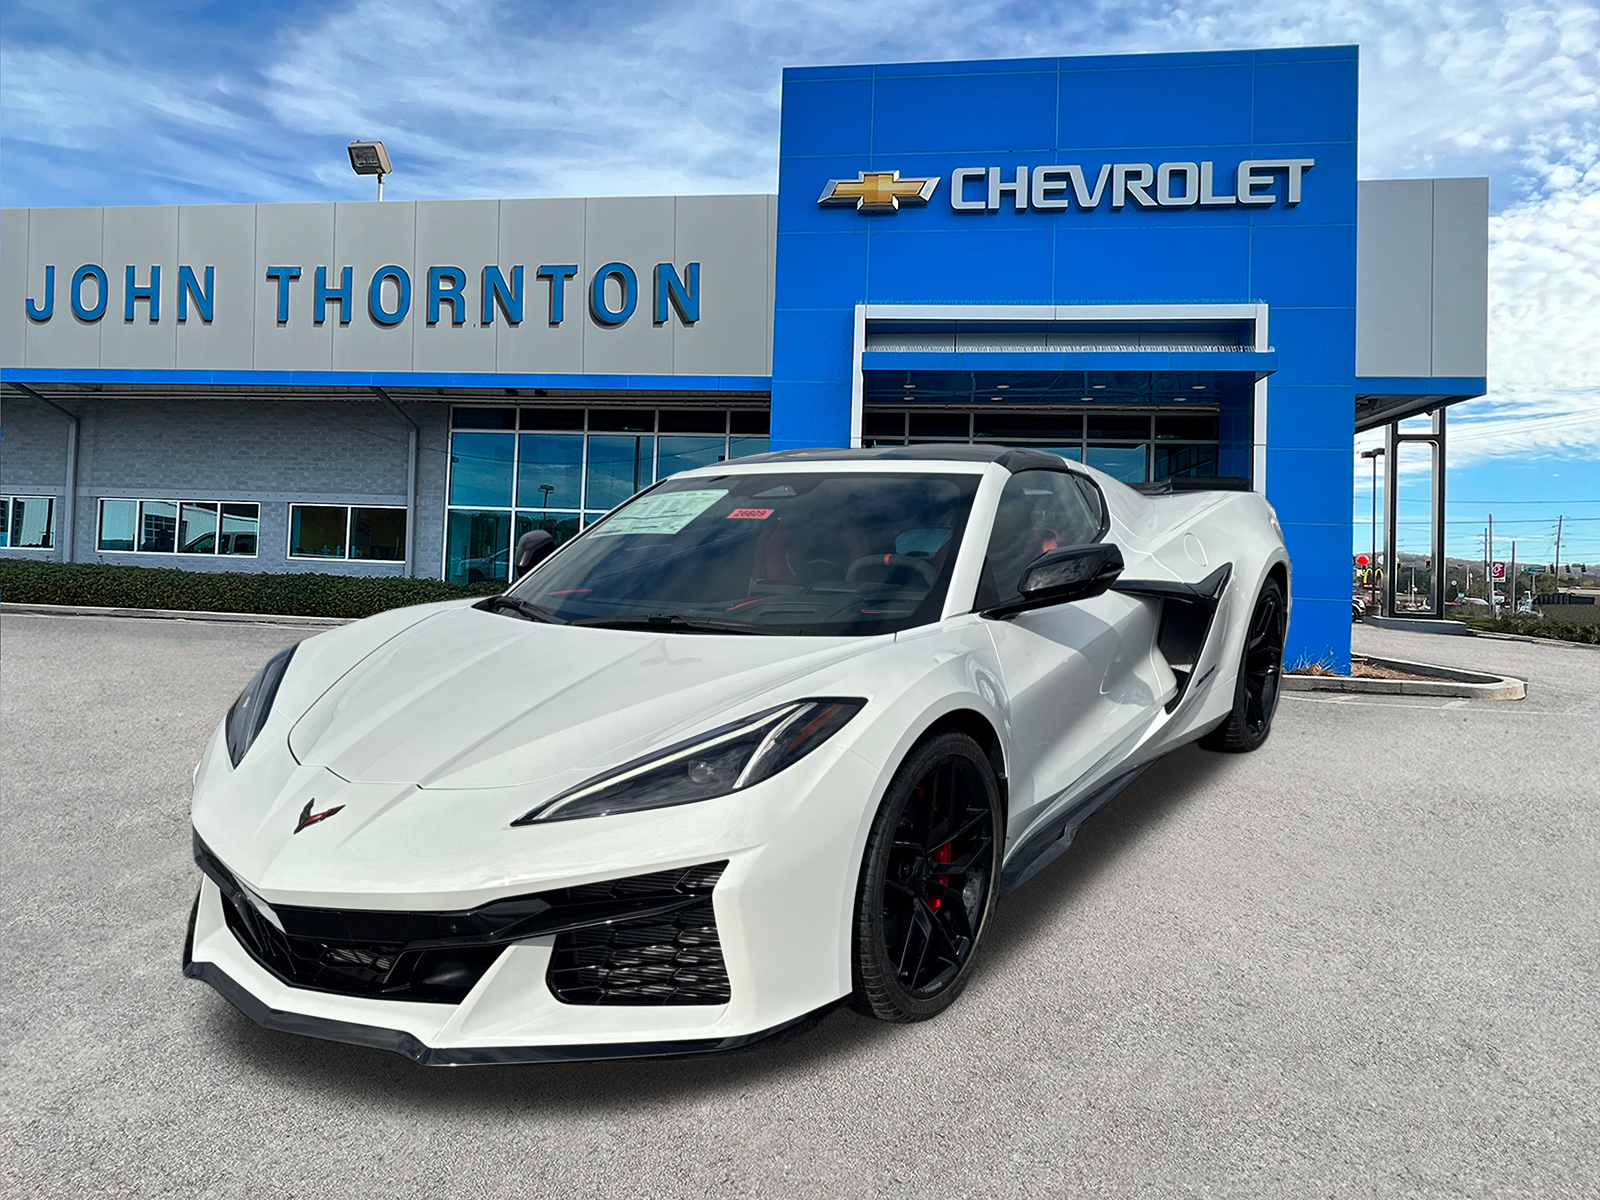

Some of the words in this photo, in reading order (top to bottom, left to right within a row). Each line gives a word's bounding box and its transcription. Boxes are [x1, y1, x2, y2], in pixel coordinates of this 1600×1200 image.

[951, 158, 1315, 212] CHEVROLET
[25, 263, 215, 324] JOHN
[266, 262, 702, 328] THORNTON
